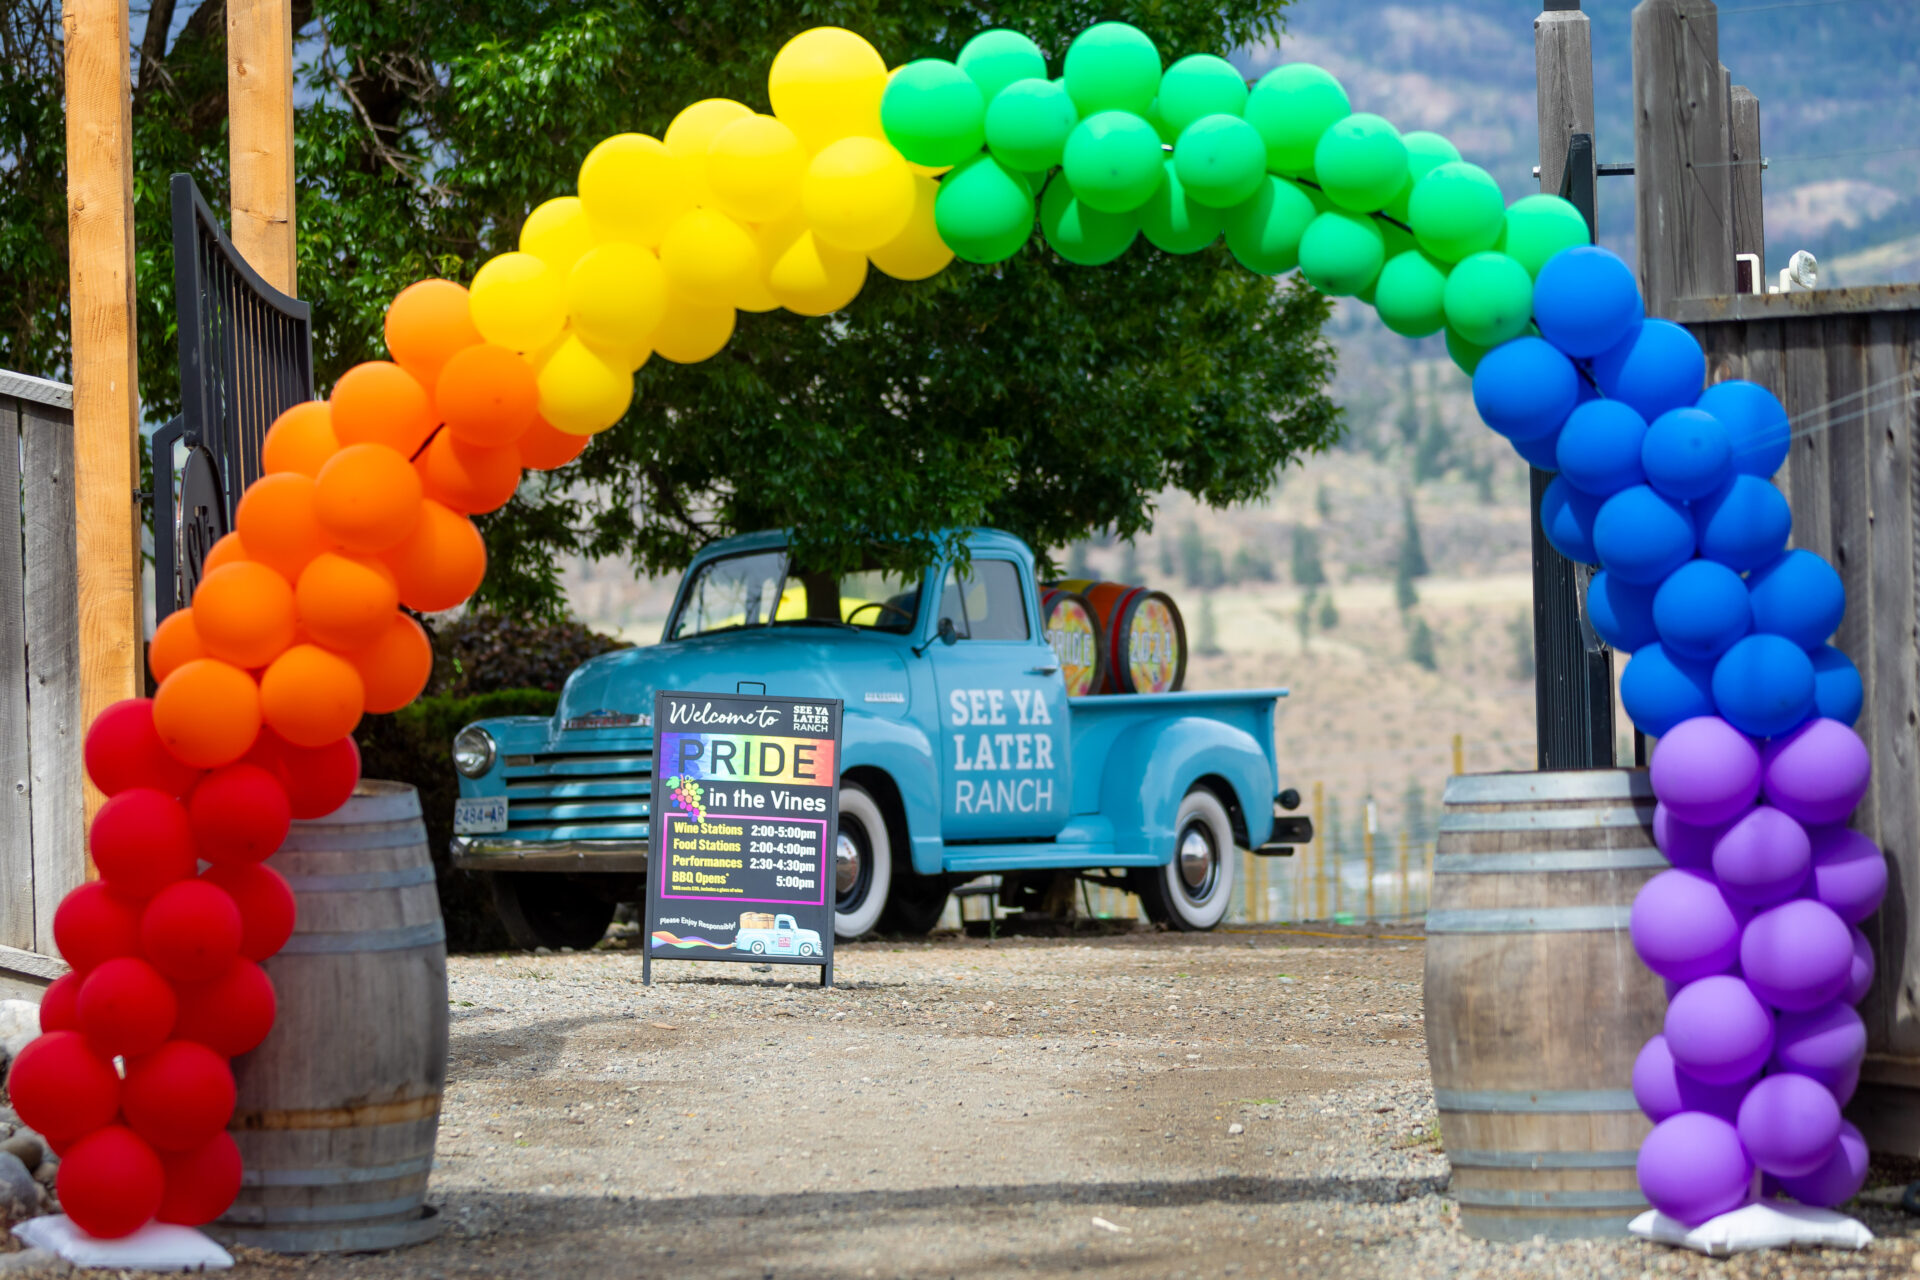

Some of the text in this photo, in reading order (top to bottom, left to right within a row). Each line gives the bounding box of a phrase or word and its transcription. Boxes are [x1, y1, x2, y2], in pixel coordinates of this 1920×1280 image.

[1131, 631, 1171, 664] 2024
[669, 701, 756, 725] Welcome
[756, 705, 782, 728] to
[793, 705, 829, 716] SEE YA
[950, 688, 1053, 726] SEE YA
[793, 713, 829, 725] LATER
[793, 723, 829, 732] RANCH
[677, 738, 818, 780] PRIDE
[953, 733, 1054, 771] LATER
[709, 787, 827, 812] in the Vines
[955, 778, 1054, 814] RANCH
[674, 821, 744, 836] Wine Stations
[751, 825, 817, 841] 2:00-5:00pm
[673, 838, 741, 852] Food Stations
[750, 841, 816, 857] 2:00-4:00pm
[672, 854, 743, 869] Performances
[750, 857, 816, 873] 2:30-4:30pm
[672, 871, 694, 884] BBQ
[776, 875, 815, 890] 5:00pm
[659, 916, 736, 931] Please Enjoy Responsibly!
